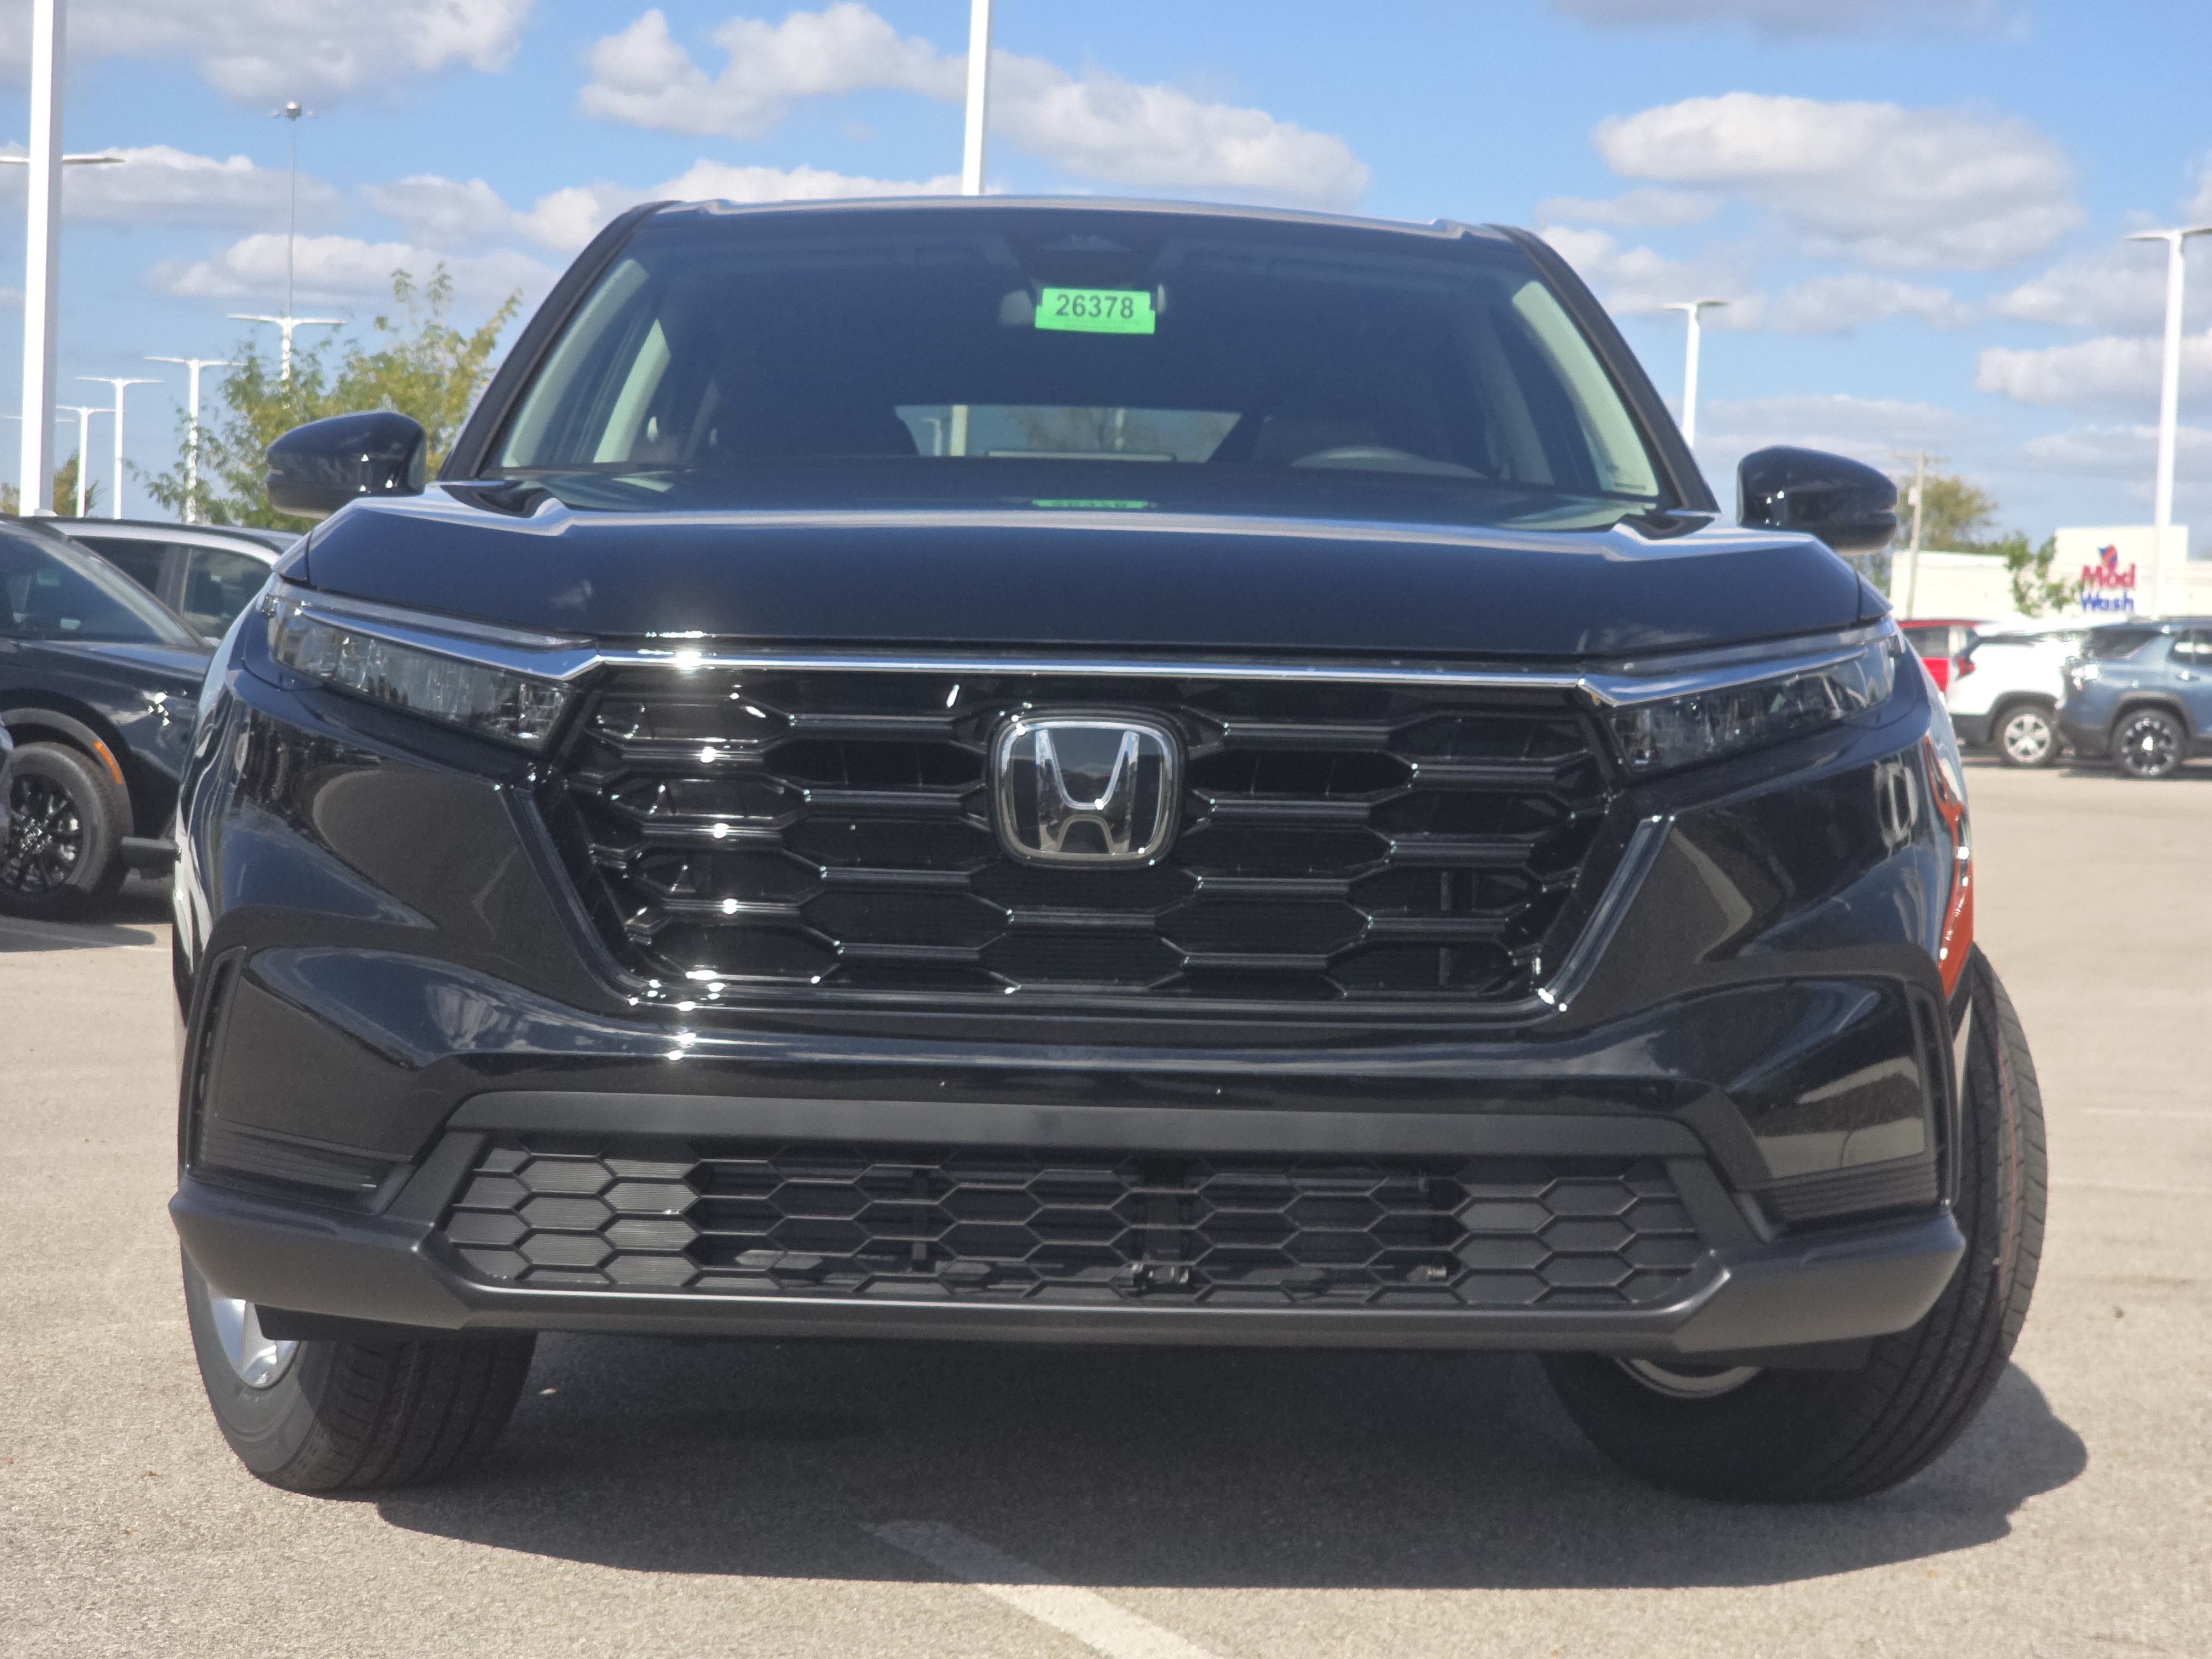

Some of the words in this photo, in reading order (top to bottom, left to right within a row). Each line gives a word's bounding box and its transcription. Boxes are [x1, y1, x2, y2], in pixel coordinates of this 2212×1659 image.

[1055, 293, 1134, 319] 26378
[2079, 563, 2136, 588] Mod
[2079, 591, 2134, 611] Wash
